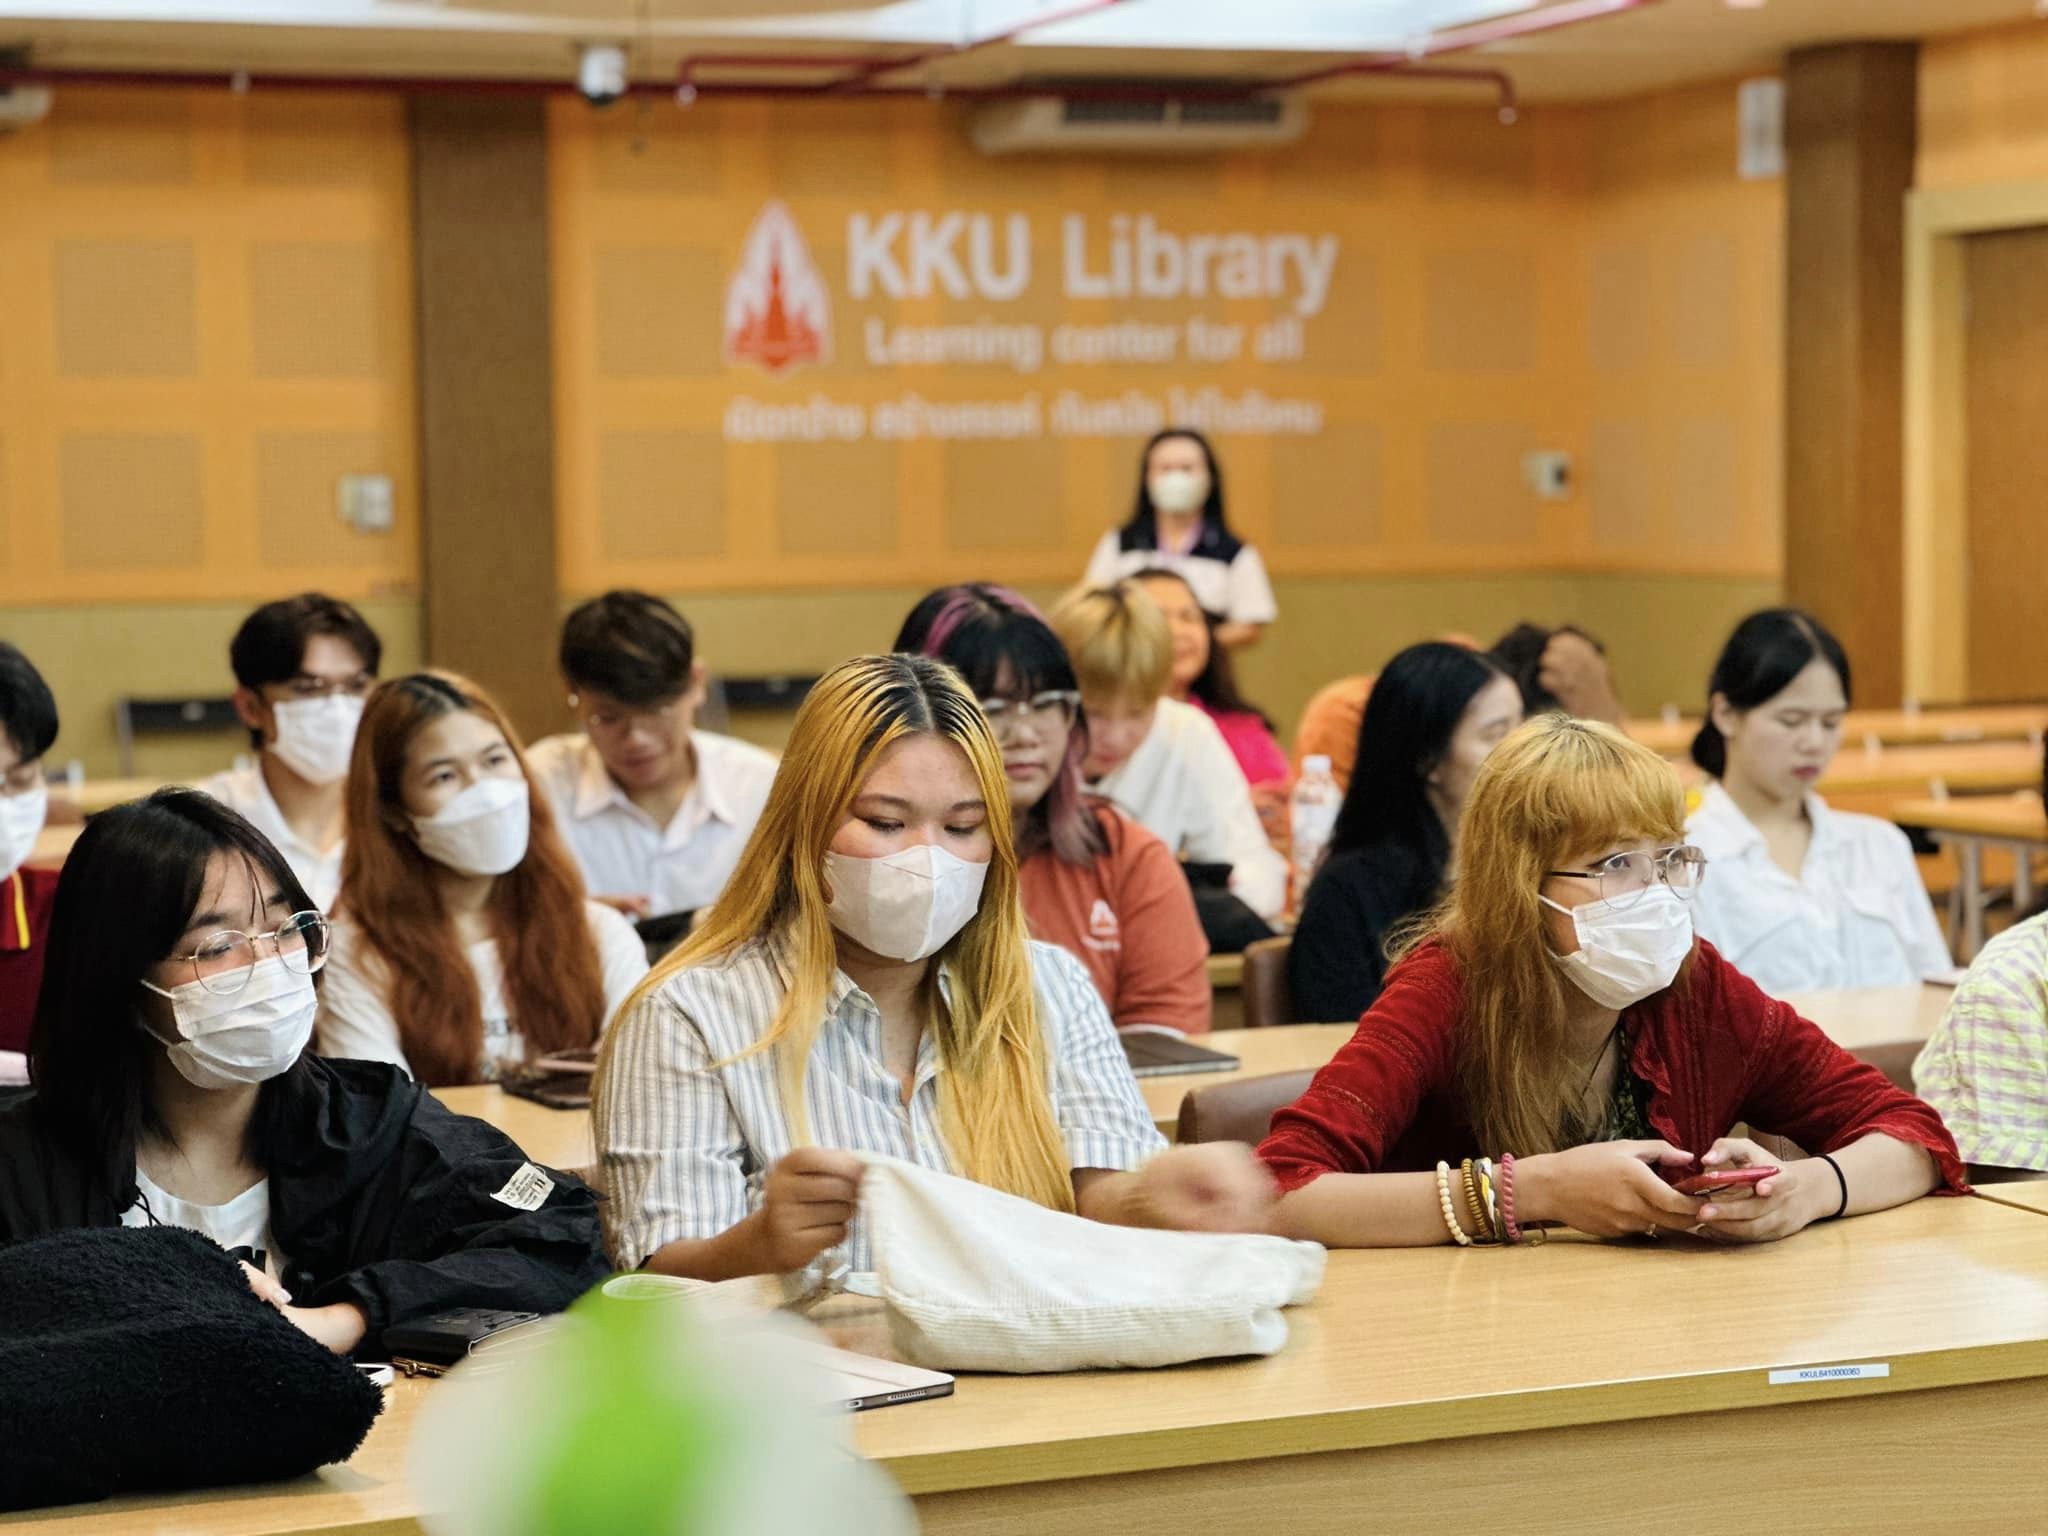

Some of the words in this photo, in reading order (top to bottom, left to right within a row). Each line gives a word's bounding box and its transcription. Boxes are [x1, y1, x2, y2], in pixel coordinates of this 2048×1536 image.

[847, 212, 1031, 300] KKU
[1060, 214, 1338, 316] Library
[864, 318, 1043, 371] Learning
[1051, 322, 1179, 362] center
[1186, 317, 1245, 361] for
[1254, 317, 1304, 360] all
